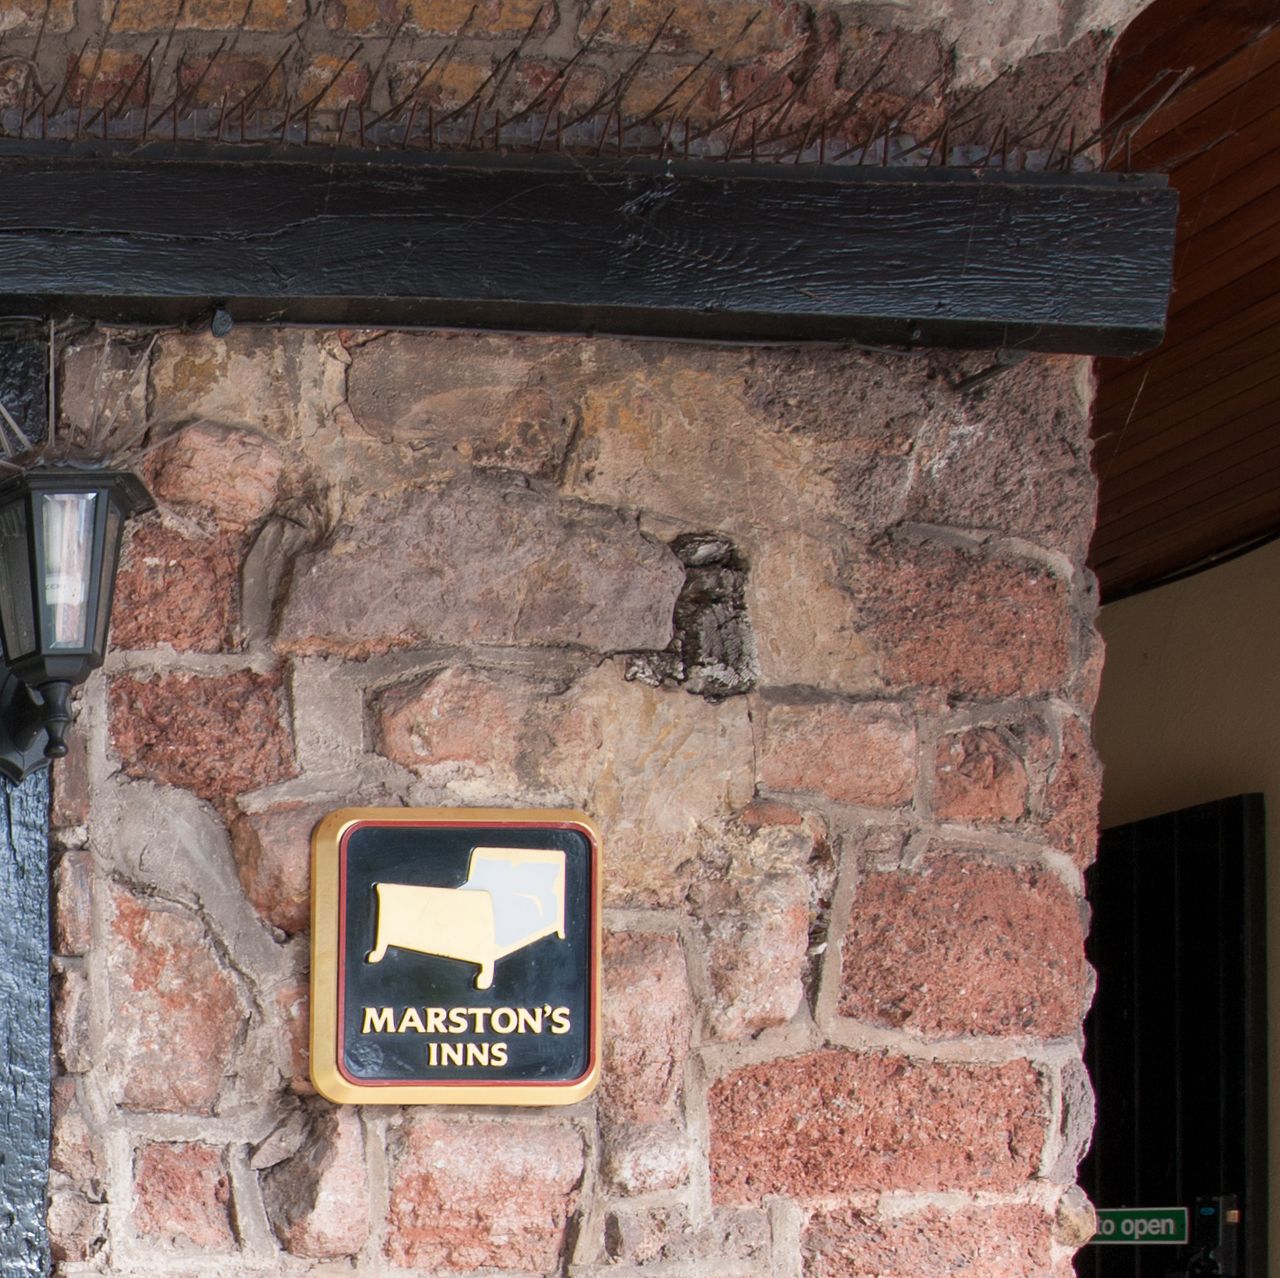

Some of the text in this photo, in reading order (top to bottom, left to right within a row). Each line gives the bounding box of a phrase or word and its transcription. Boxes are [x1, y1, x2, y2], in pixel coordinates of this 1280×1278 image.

[361, 1003, 572, 1035] MARSTON'S
[427, 1041, 509, 1067] INNS
[1120, 1217, 1175, 1240] open
